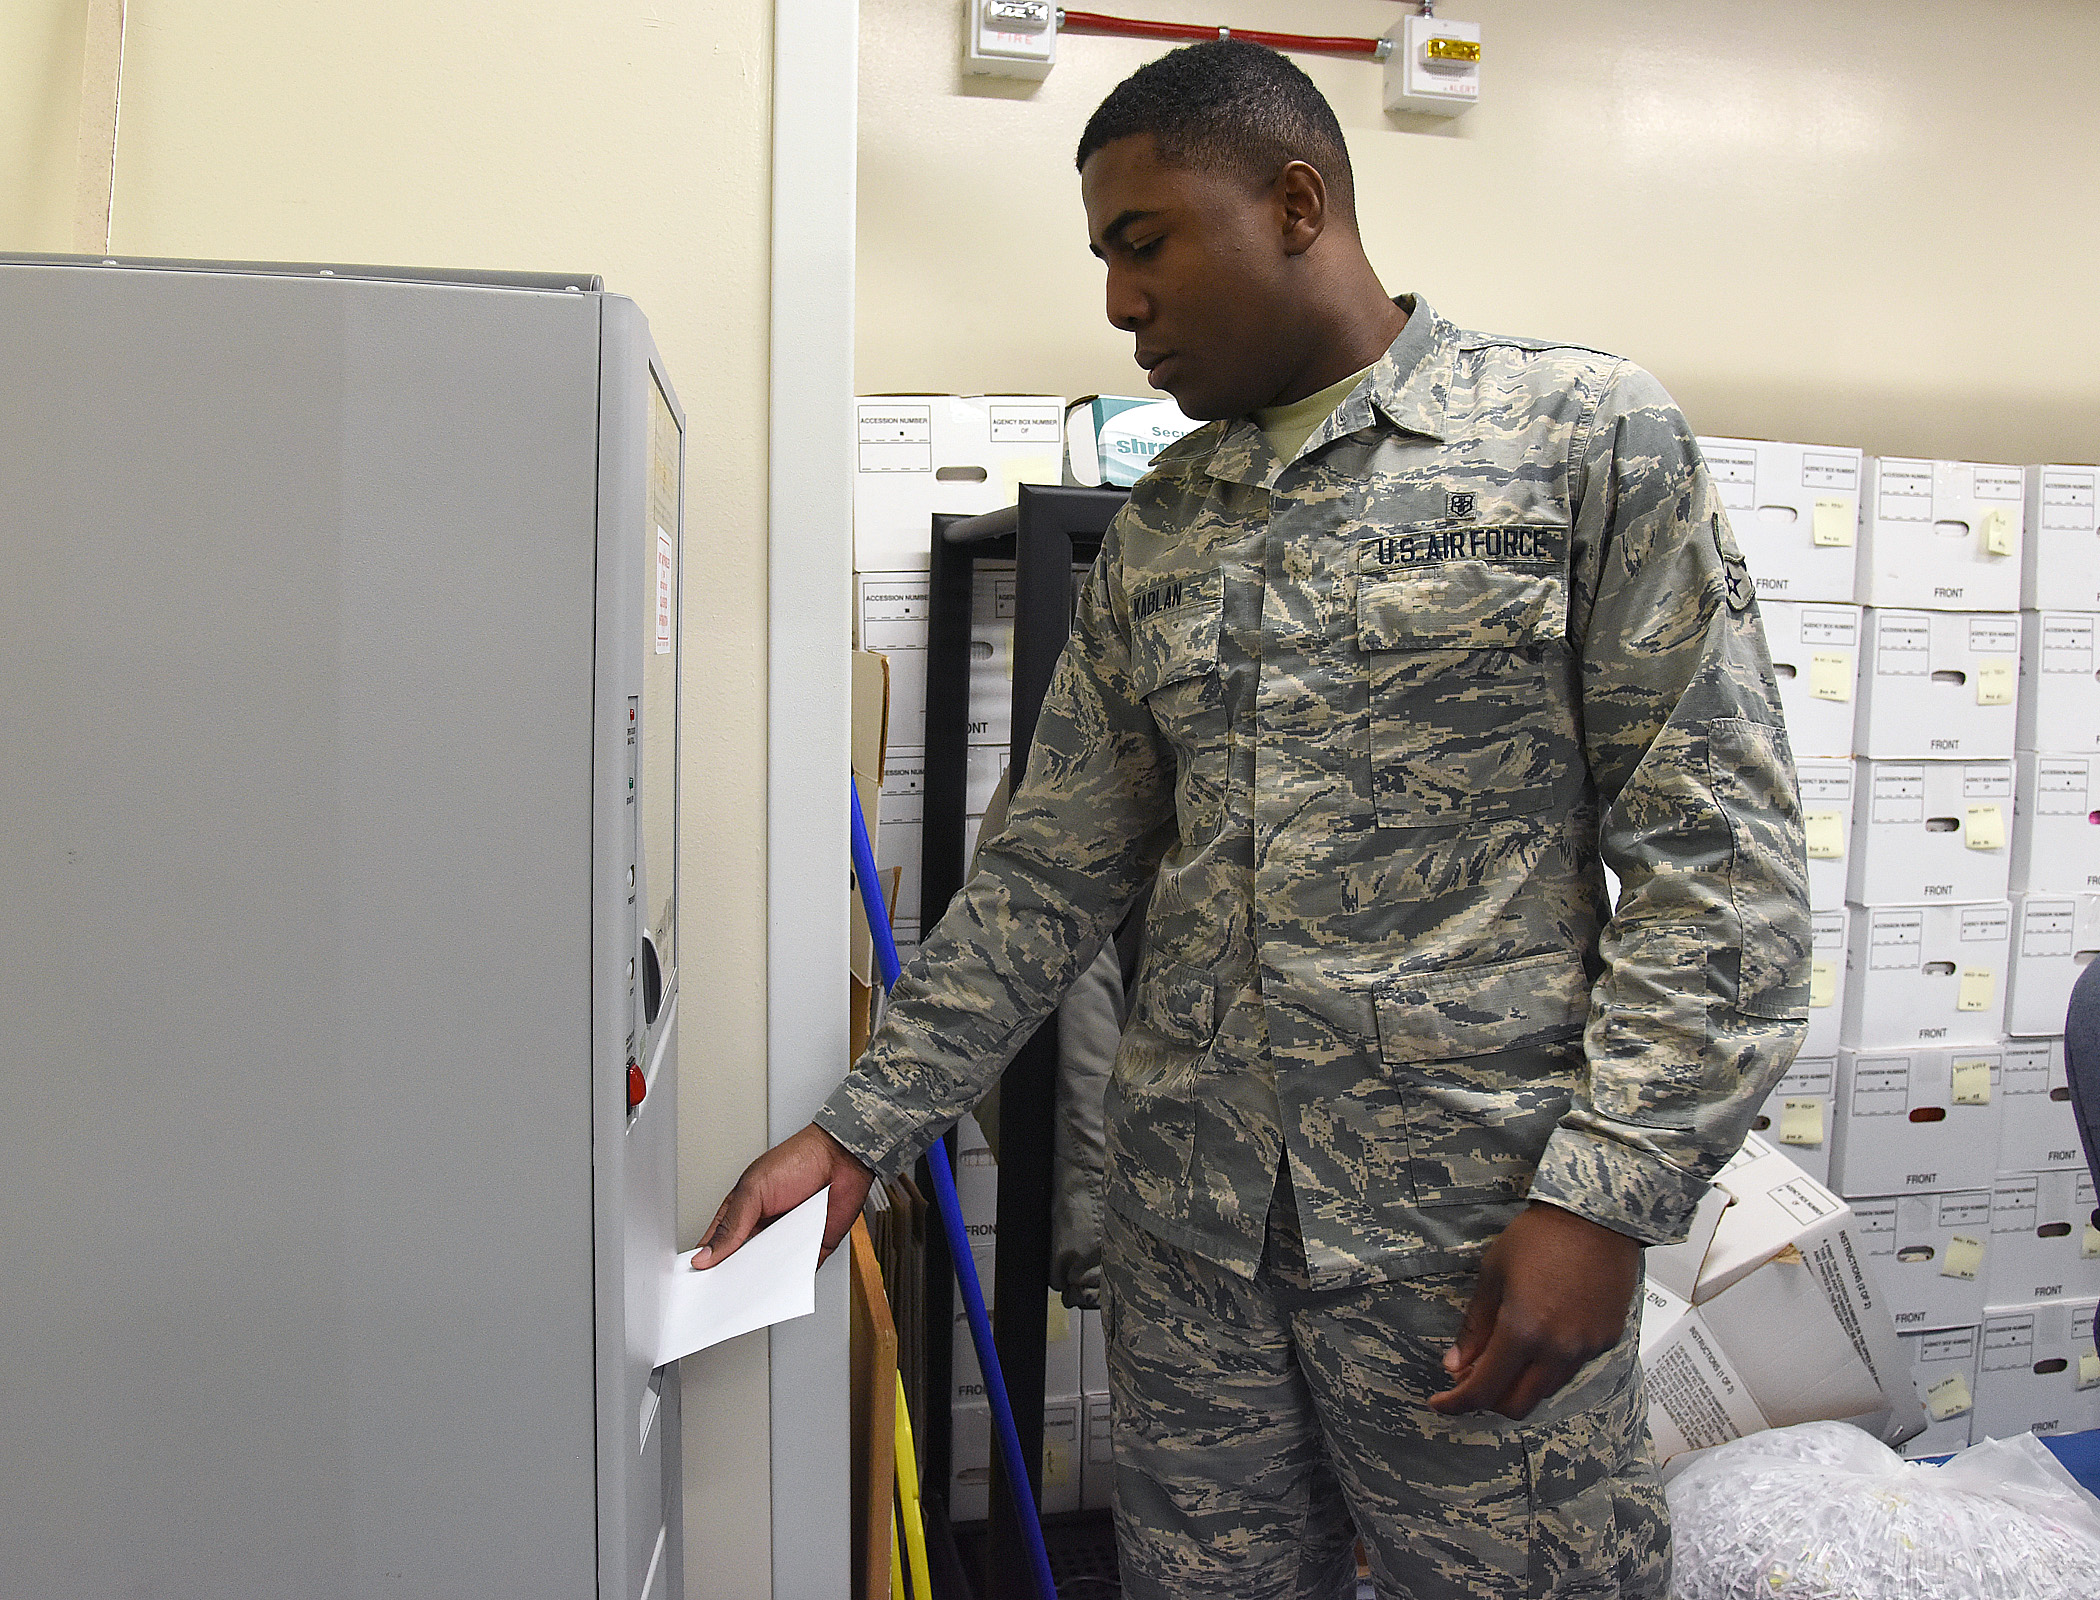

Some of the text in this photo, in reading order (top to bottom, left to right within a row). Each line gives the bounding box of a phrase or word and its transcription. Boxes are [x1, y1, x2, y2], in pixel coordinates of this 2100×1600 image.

[997, 31, 1033, 45] FIRE
[1449, 84, 1477, 94] ALERT
[1427, 530, 1465, 561] AIR
[1470, 528, 1547, 557] FORCE
[1756, 578, 1789, 590] FRONT
[1934, 587, 1964, 598] FRONT
[1132, 582, 1182, 622] KABLAN
[1930, 739, 1960, 750] FRONT
[1924, 885, 1953, 896] FRONT
[1918, 1028, 1947, 1039] FRONT
[2048, 1150, 2076, 1161] FRONT
[1906, 1173, 1937, 1185] FRONT
[965, 1225, 997, 1237] FRON
[1839, 1229, 1862, 1282] INSTRUCTIONS
[2034, 1285, 2063, 1297] FRONT
[1647, 1292, 1667, 1308] END
[1895, 1312, 1926, 1324] FRONT
[1688, 1325, 1721, 1371] INSTRUCTIONS
[958, 1385, 987, 1396] FRO
[2031, 1420, 2059, 1433] FRONT
